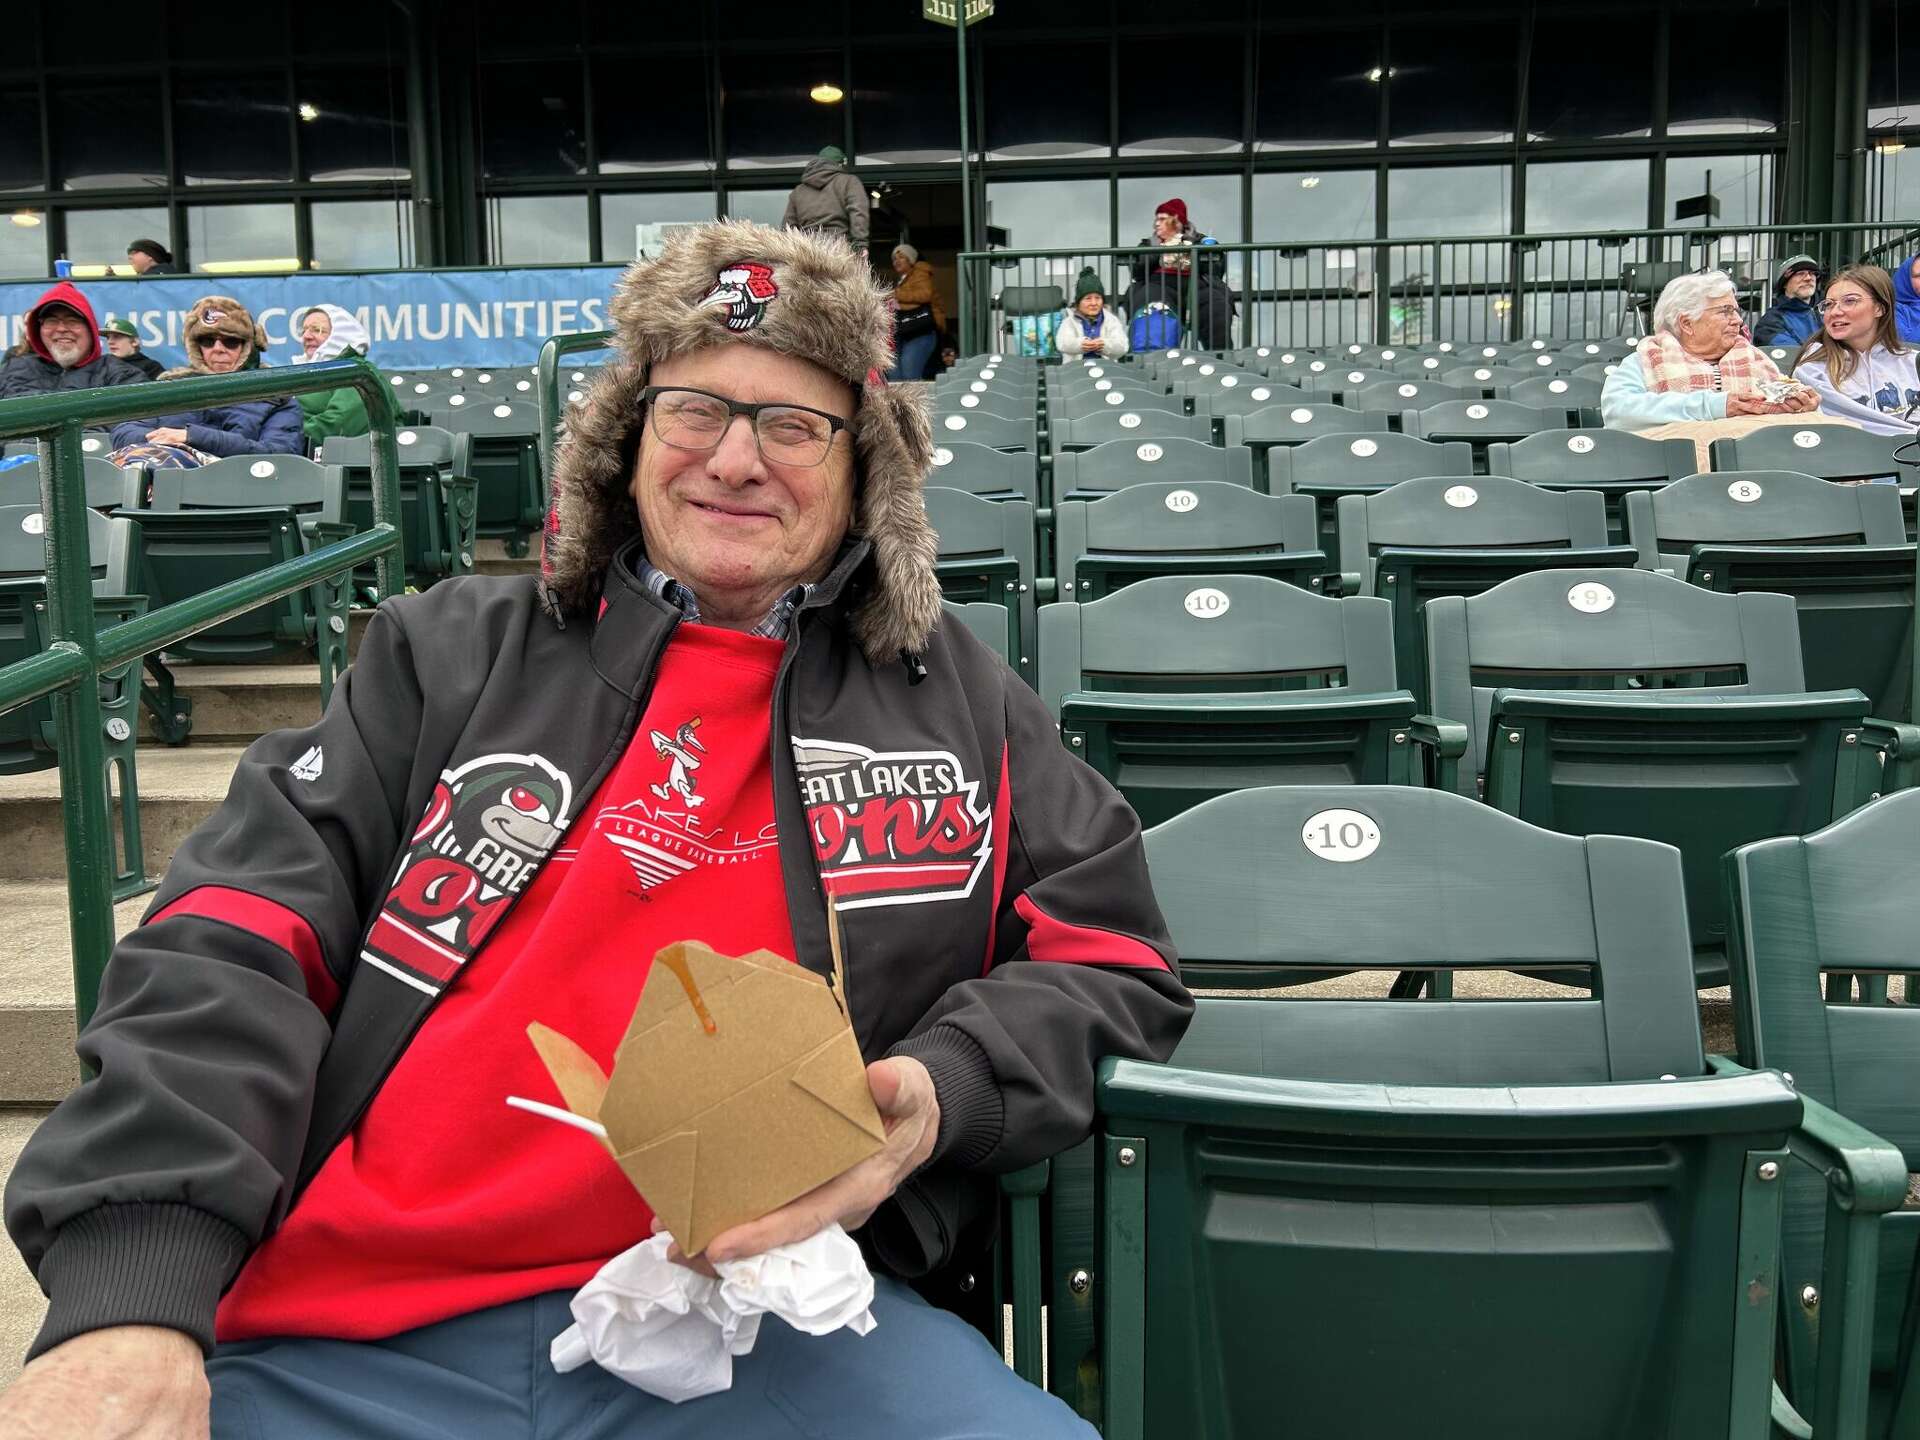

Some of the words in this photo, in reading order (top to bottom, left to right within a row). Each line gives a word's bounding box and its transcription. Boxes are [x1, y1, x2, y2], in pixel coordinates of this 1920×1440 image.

[1577, 440, 1586, 449] 8
[1802, 435, 1811, 444] 7
[1143, 448, 1157, 457] 10
[1740, 486, 1750, 497] 8
[1172, 495, 1190, 507] 10
[1194, 595, 1220, 611] 10
[1583, 590, 1598, 605] 9
[851, 764, 954, 799] LAKES
[615, 821, 682, 852] LEAGUE
[807, 796, 983, 863] ons
[1318, 822, 1364, 849] 10
[465, 837, 539, 893] GRE
